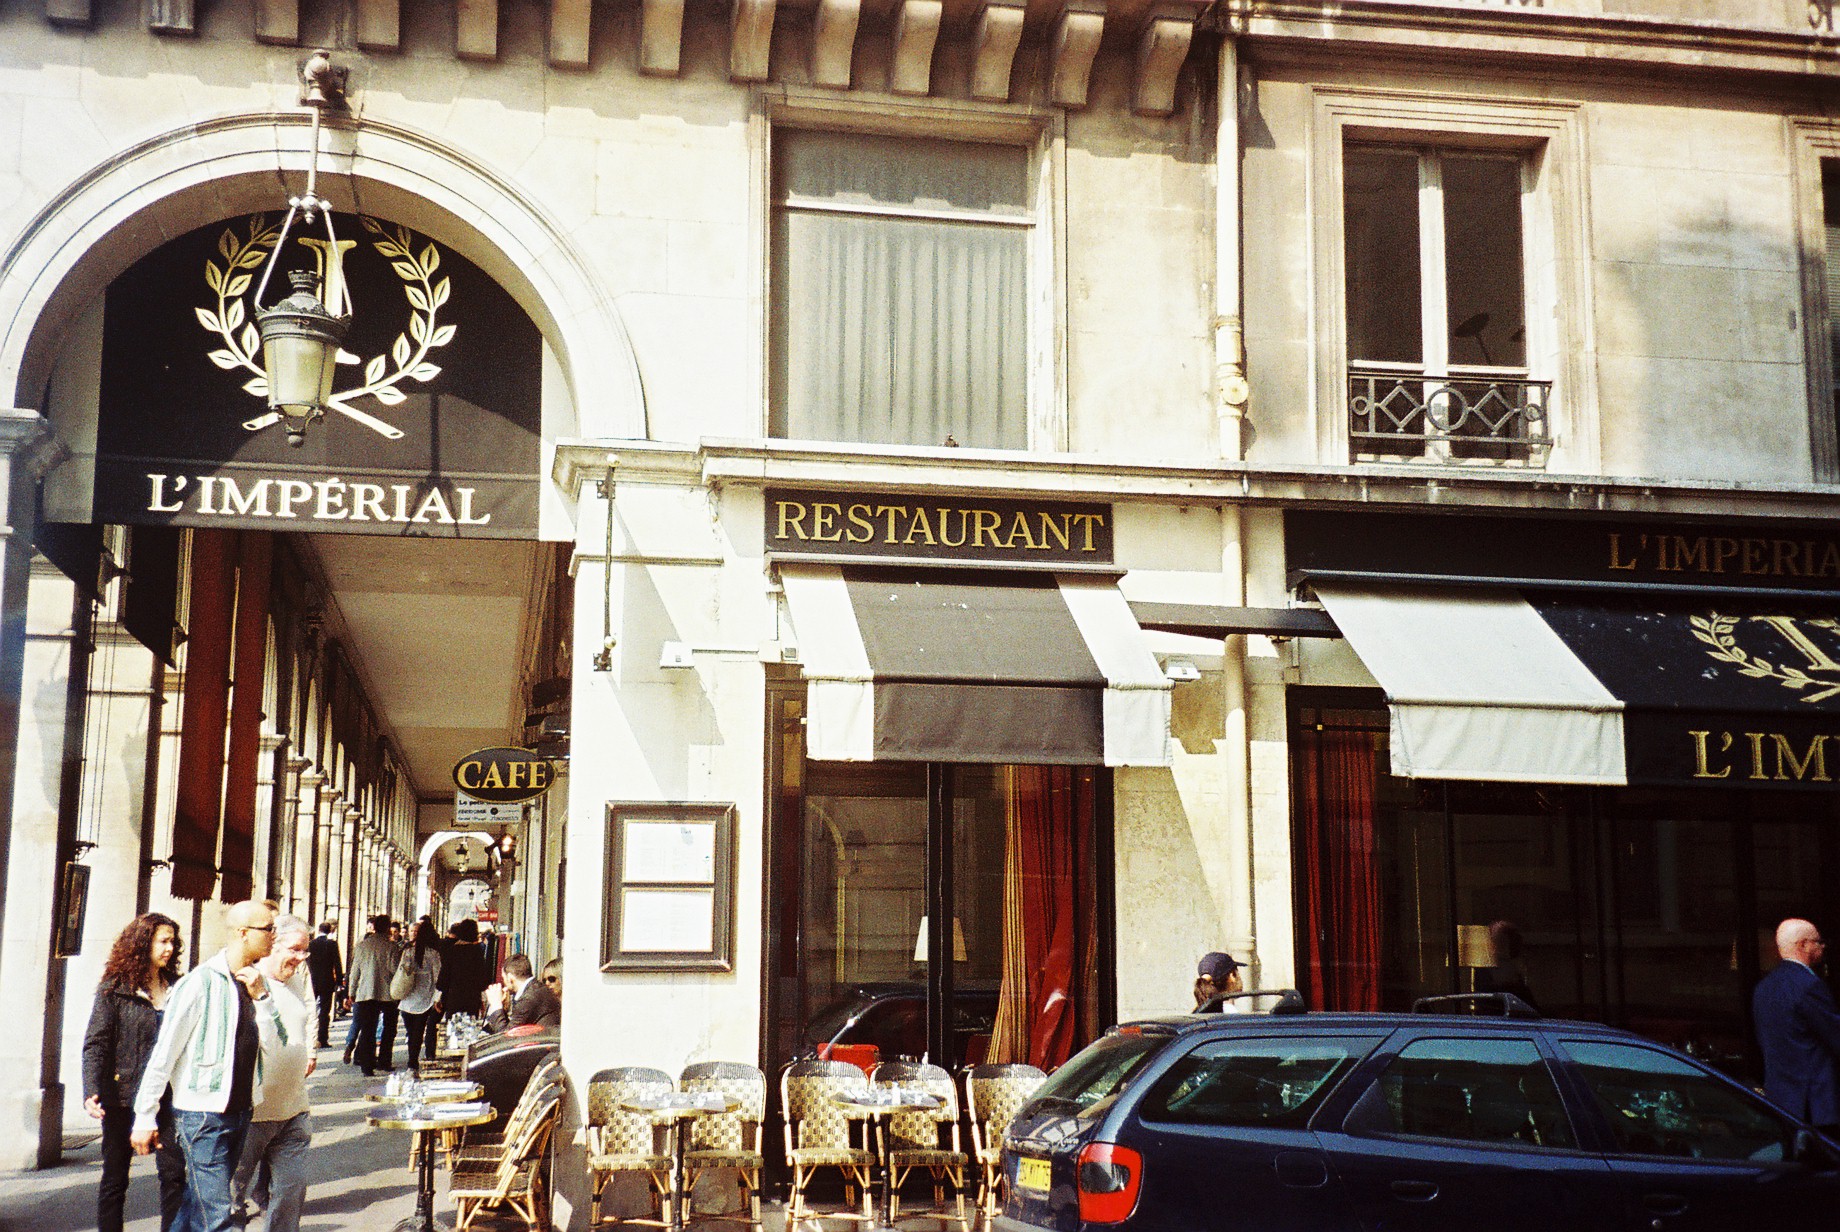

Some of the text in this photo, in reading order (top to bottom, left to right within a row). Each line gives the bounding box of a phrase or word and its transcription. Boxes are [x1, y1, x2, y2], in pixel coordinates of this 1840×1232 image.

[146, 473, 491, 525] L'IMPÉRIAL
[774, 500, 1105, 552] RESTAURANT
[457, 760, 547, 789] CAFE
[1688, 730, 1840, 782] L'IM
